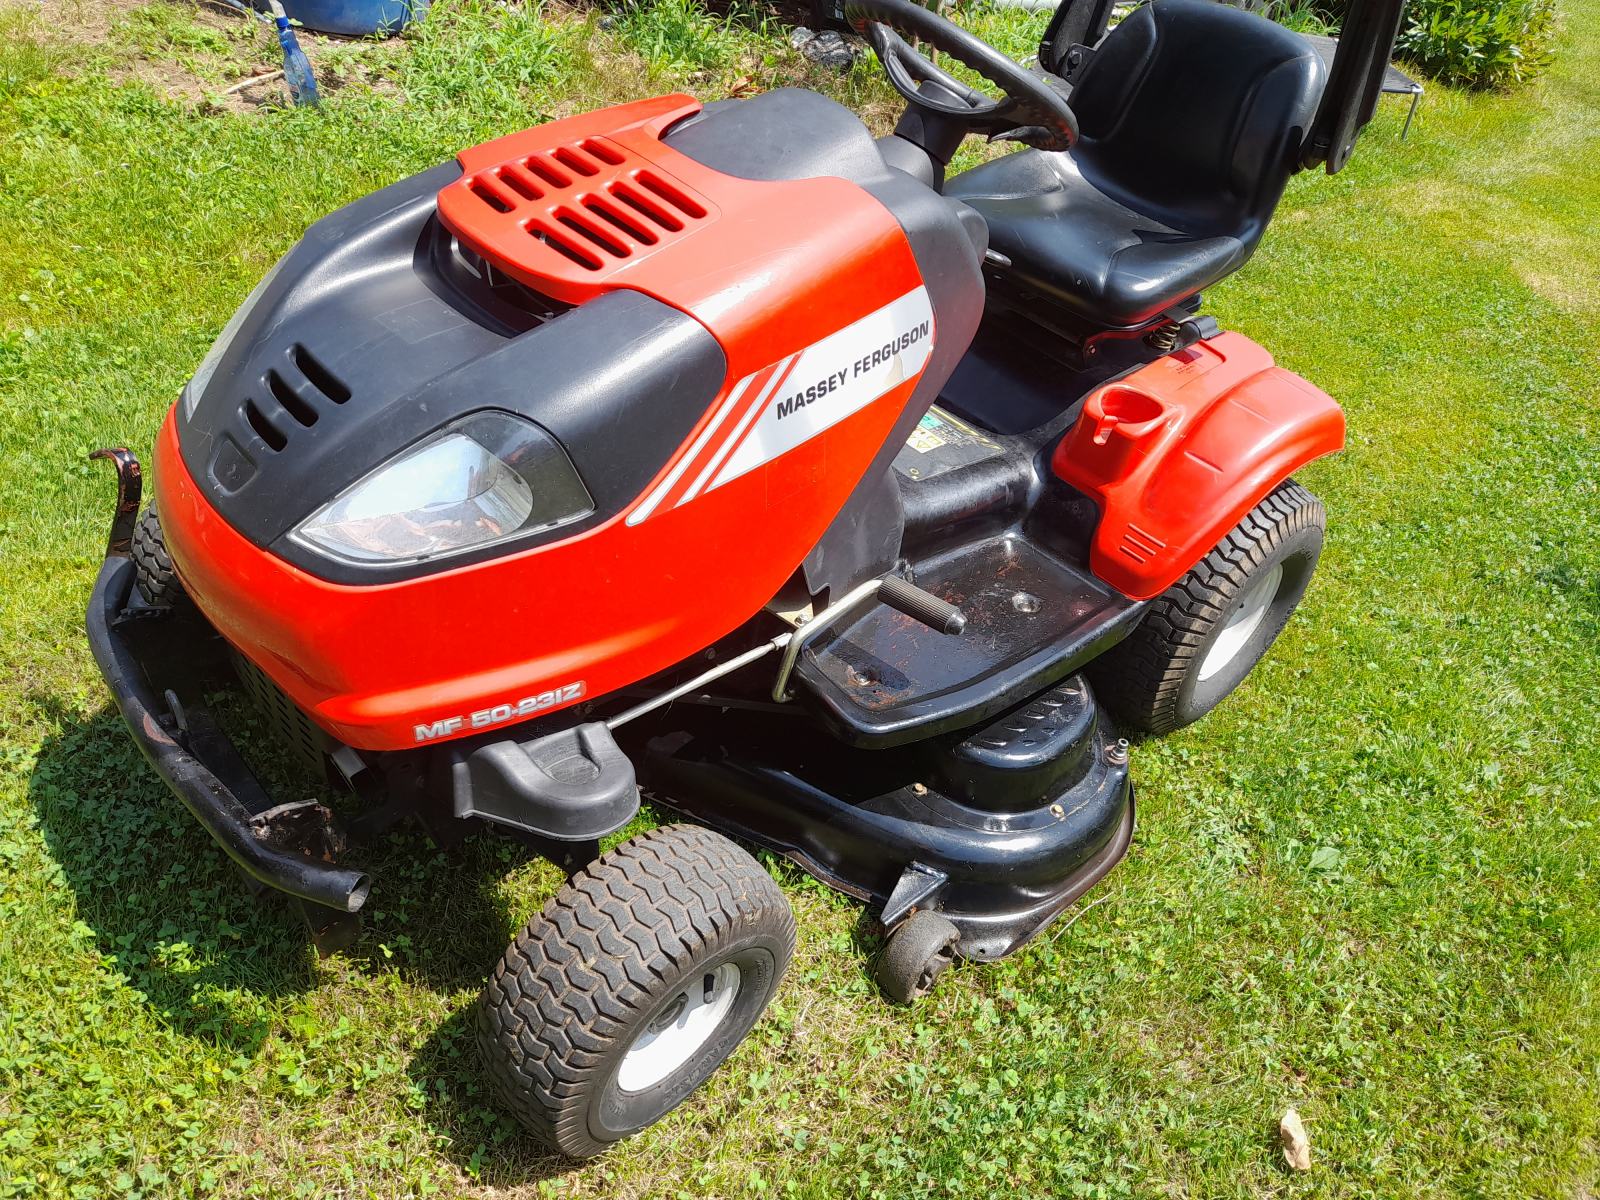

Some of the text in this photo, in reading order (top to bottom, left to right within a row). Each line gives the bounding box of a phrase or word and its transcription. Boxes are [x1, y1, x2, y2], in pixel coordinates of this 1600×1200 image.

[776, 319, 930, 420] MASSEY FERGUSON
[414, 717, 464, 742] MF
